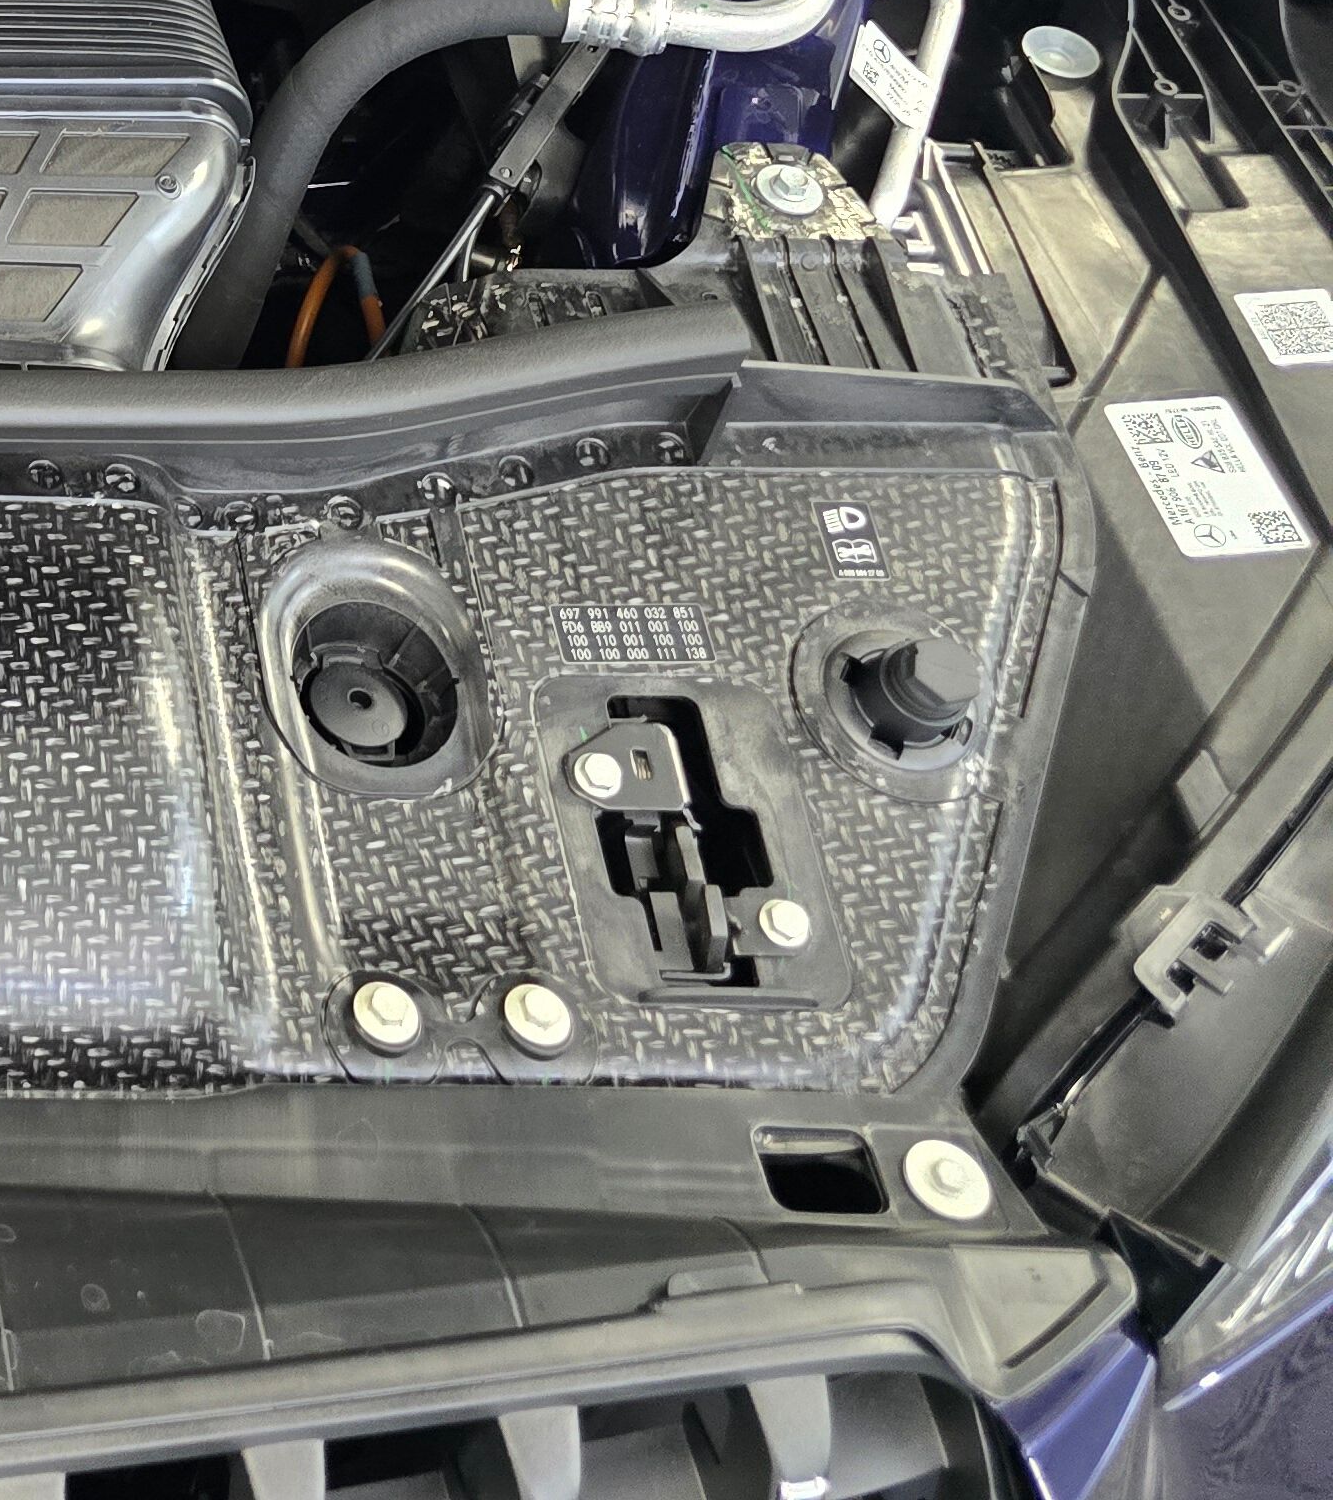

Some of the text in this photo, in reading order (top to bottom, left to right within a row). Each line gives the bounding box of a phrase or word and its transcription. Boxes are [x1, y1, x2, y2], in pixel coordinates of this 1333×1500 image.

[1173, 413, 1199, 446] HELLA
[1147, 459, 1163, 471] 09
[1154, 447, 1180, 478] LED 12V
[1147, 478, 1182, 525] Mercedes
[1174, 503, 1190, 516] 167
[560, 607, 694, 619] 697 991 460 032 851
[562, 621, 584, 633] FD6
[619, 621, 641, 632] 011
[648, 621, 669, 632] 001
[678, 620, 699, 632] 100
[568, 634, 703, 647] 100 110 001 100 100
[571, 647, 707, 660] 100 100 000 111 138
